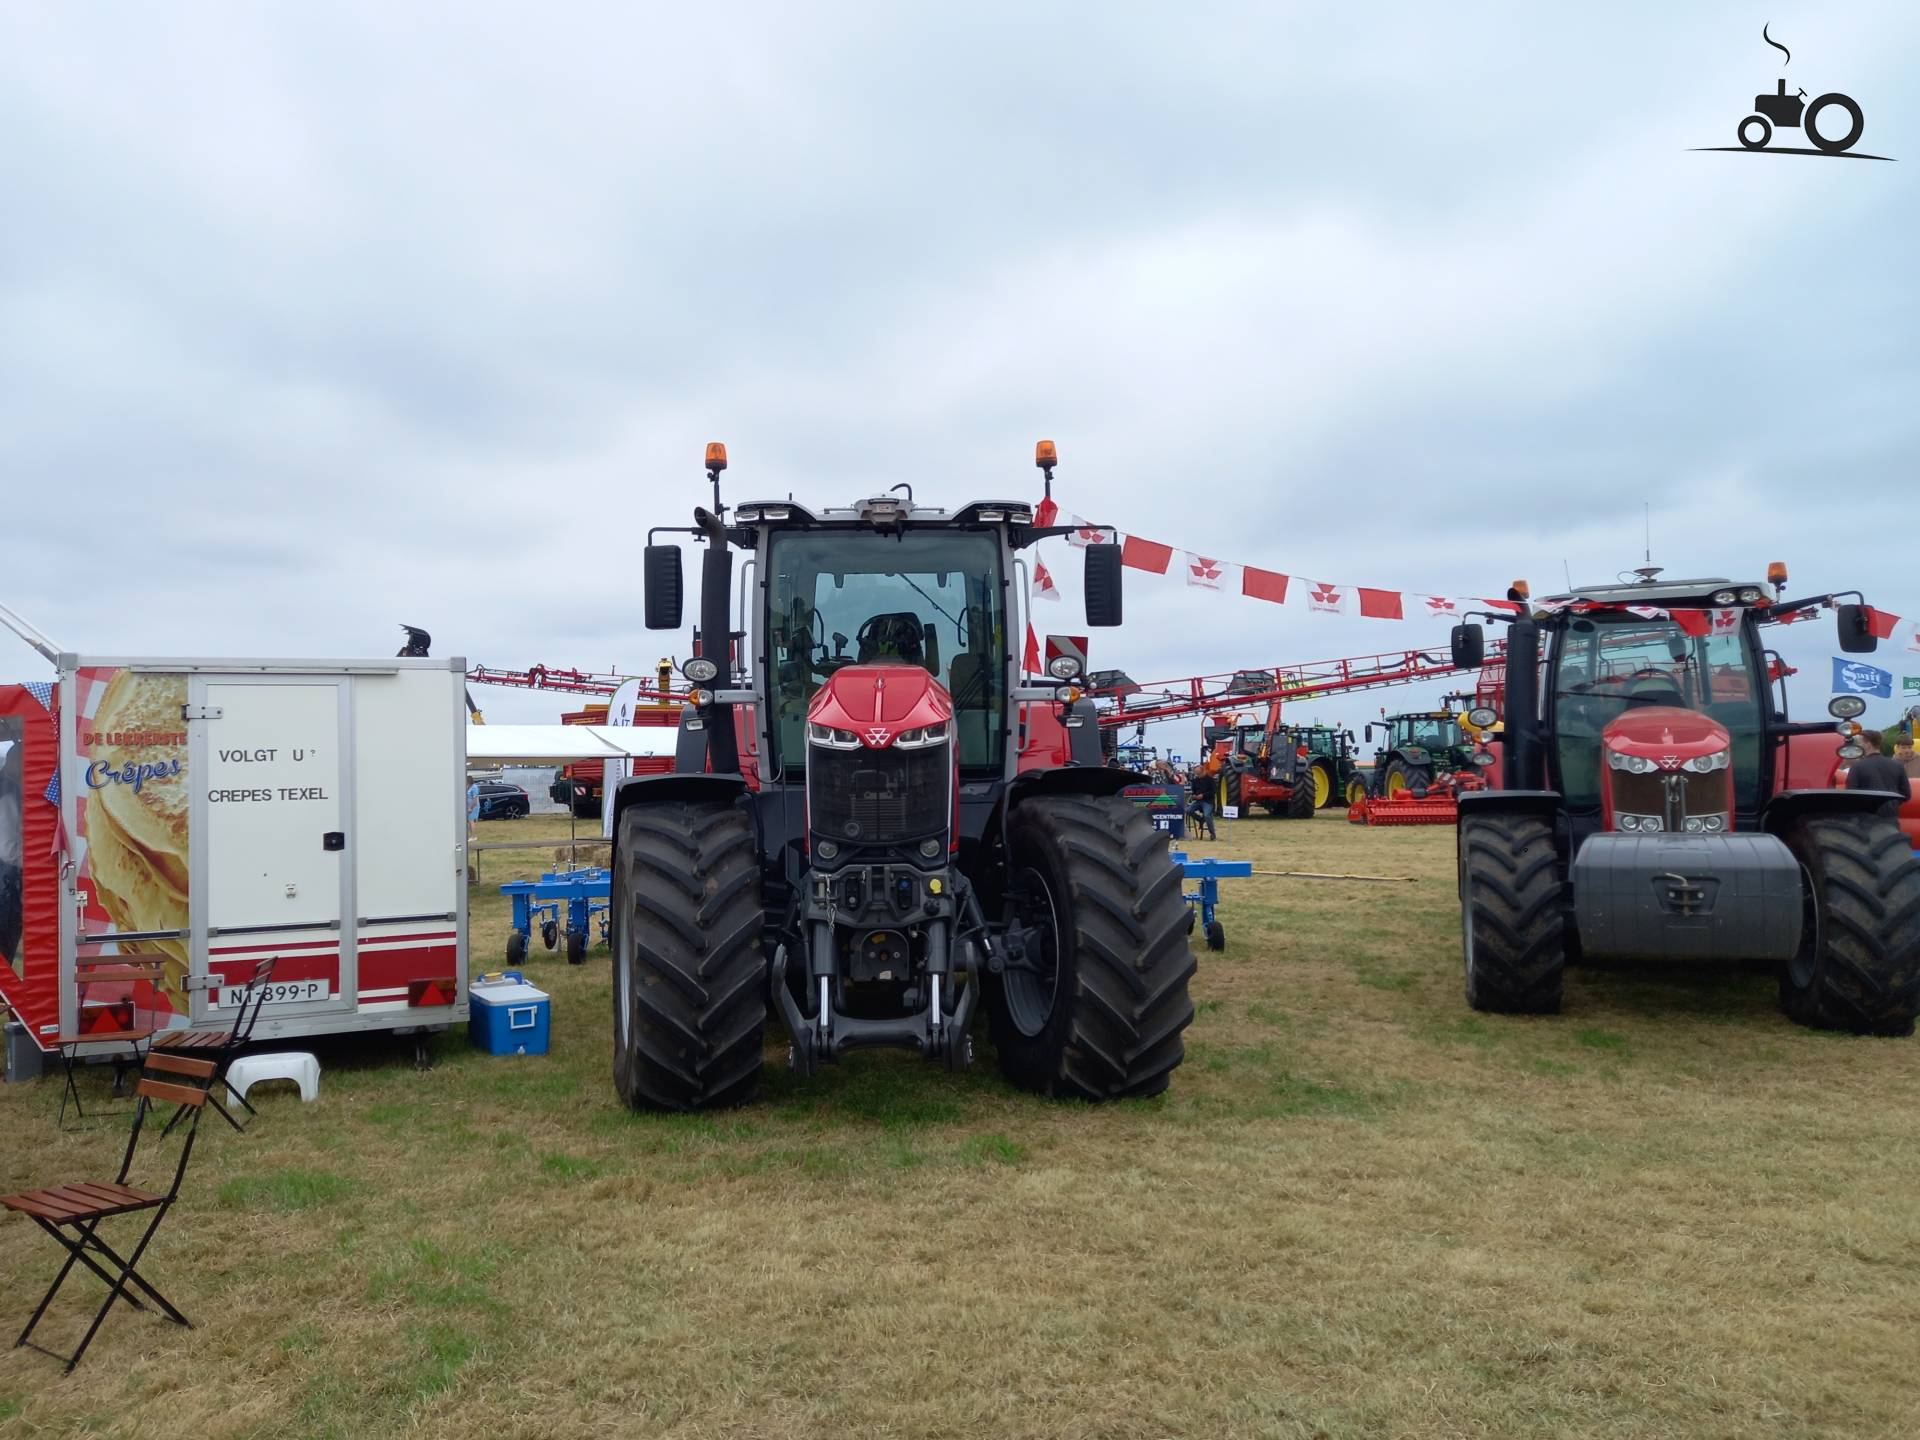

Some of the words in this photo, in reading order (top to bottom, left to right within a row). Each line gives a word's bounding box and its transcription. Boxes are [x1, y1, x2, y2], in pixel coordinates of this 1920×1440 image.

[83, 732, 103, 746] DE
[219, 748, 278, 762] VOLGT
[292, 749, 304, 761] U
[208, 788, 272, 802] CREPES
[277, 787, 328, 800] TEXEL
